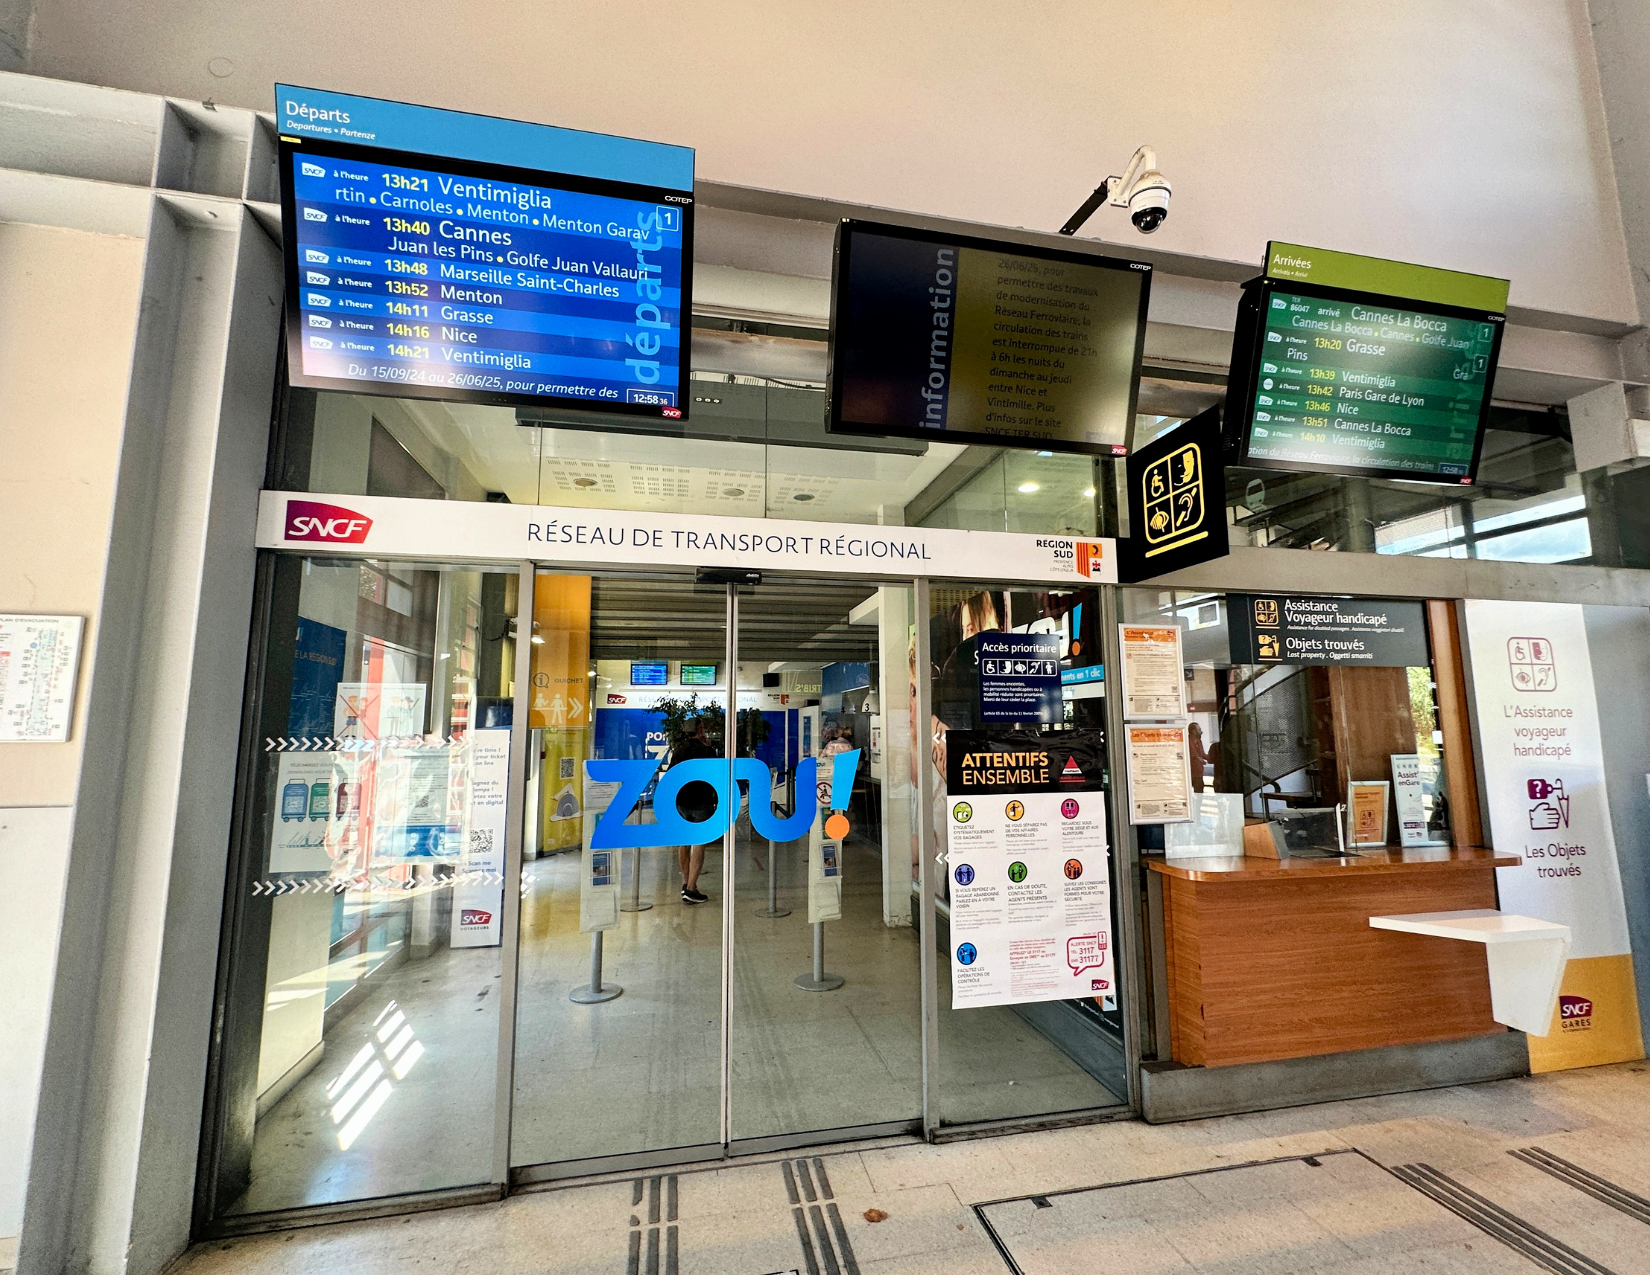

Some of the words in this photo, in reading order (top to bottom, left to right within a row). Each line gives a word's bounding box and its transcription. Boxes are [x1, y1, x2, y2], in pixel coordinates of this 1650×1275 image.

[286, 101, 350, 123] Départs
[287, 120, 332, 133] Departures
[340, 128, 375, 140] Partenze
[333, 169, 338, 178] à
[340, 171, 369, 181] l'heure
[382, 171, 428, 192] 13h21
[438, 176, 551, 210] Ventimiglia
[335, 187, 365, 203] rtin
[380, 191, 453, 214] Carnoles
[467, 203, 529, 225] Menton
[543, 213, 602, 235] Menton
[606, 222, 650, 241] Garav
[664, 212, 672, 226] 1
[334, 214, 340, 222] à
[342, 215, 370, 226] l'heure
[383, 217, 430, 235] 13h40
[439, 220, 512, 246] Cannes
[388, 236, 428, 255] Juan
[434, 242, 456, 258] les
[461, 245, 494, 262] Pins
[506, 250, 549, 270] Golfe
[551, 256, 589, 274] Juan
[592, 260, 648, 281] Vallauri
[1273, 254, 1312, 269] Arrivées
[336, 255, 342, 263] à
[343, 256, 372, 267] l'heure
[384, 259, 428, 275] 13h48
[440, 263, 512, 285] Marseille
[517, 272, 620, 298] Saint-Charles
[337, 276, 343, 284] à
[344, 277, 373, 288] l'heure
[385, 281, 429, 297] 13h52
[441, 285, 503, 305] Menton
[625, 211, 671, 385] départs
[338, 298, 344, 306] à
[345, 299, 373, 310] l'heure
[386, 302, 428, 317] 14h11
[441, 306, 494, 324] Grasse
[1318, 307, 1340, 317] arrivé
[1351, 306, 1394, 324] Cannes
[1397, 313, 1410, 327] La
[1413, 315, 1447, 332] Bocca
[339, 320, 345, 328] à
[345, 320, 374, 331] l'heure
[386, 323, 430, 339] 14h16
[442, 326, 478, 344] Nice
[919, 248, 954, 429] information
[1292, 315, 1328, 330] Cannes
[1331, 320, 1341, 332] La
[1344, 322, 1373, 336] Bocca
[1380, 327, 1414, 342] Cannes
[1421, 333, 1446, 346] Golfe
[1447, 337, 1469, 349] Juan
[1483, 328, 1489, 337] 1
[1287, 347, 1308, 361] Pins
[1314, 337, 1342, 350] 13h20
[1346, 339, 1386, 356] Grasse
[340, 341, 346, 349] à
[346, 342, 375, 352] l'heure
[387, 344, 429, 360] 14h21
[442, 347, 531, 370] Ventimiglia
[991, 351, 997, 361] à
[1013, 355, 1026, 365] les
[1028, 357, 1050, 367] nuits
[1053, 358, 1065, 369] du
[1478, 359, 1484, 368] 1
[348, 364, 367, 376] Du
[371, 366, 426, 383] 15/09/24
[428, 373, 445, 384] au
[448, 373, 504, 390] 26/06/25,
[506, 380, 536, 392] pour
[537, 381, 597, 398] permettre
[599, 387, 619, 399] des
[990, 367, 1035, 382] dimanche
[1037, 373, 1048, 382] au
[1049, 373, 1072, 388] jeudi
[1309, 368, 1335, 380] 13h39
[1342, 371, 1395, 388] Ventimiglia
[988, 384, 1013, 394] entre
[1015, 384, 1036, 396] Nice
[1038, 388, 1047, 397] et
[1307, 384, 1333, 396] 13h42
[1339, 387, 1362, 399] Paris
[1364, 390, 1386, 402] Gare
[1389, 393, 1401, 403] de
[1402, 394, 1424, 407] Lyon
[633, 393, 659, 405] 12:58
[1036, 401, 1055, 413] Plus
[1304, 400, 1331, 412] 13h46
[1337, 403, 1359, 414] Nice
[663, 409, 682, 417] SNCF
[986, 412, 1016, 424] d'infos
[1018, 415, 1032, 425] sur
[1035, 416, 1043, 426] le
[1045, 417, 1062, 428] site
[1302, 416, 1328, 427] 13h51
[1334, 418, 1368, 432] Cannes
[1371, 422, 1381, 432] La
[1384, 423, 1411, 436] Bocca
[1300, 432, 1326, 443] 14h10
[1332, 434, 1385, 450] Ventimiglia
[288, 517, 367, 538] SNCF
[527, 519, 625, 546] RÉSEAU
[632, 529, 663, 547] DE
[671, 530, 814, 555] TRANSPORT
[819, 535, 932, 560] RÉGIONAL
[1036, 538, 1073, 550] RÉGION
[1054, 549, 1073, 558] SUD
[1284, 599, 1338, 612] Assistance
[1285, 611, 1333, 626] Voyageur
[1336, 612, 1388, 628] handicapé
[982, 642, 1009, 652] Accès
[1011, 643, 1057, 654] prioritaire
[1285, 637, 1322, 652] Objets
[1324, 638, 1365, 651] trouvés
[1287, 651, 1300, 659] Lost
[1300, 651, 1326, 660] property
[1329, 651, 1351, 660] Oggetti
[554, 677, 583, 685] GUICHET
[1503, 705, 1574, 719] L'Assistance
[1514, 726, 1568, 741] voyageur
[491, 752, 506, 760] ticket
[1513, 743, 1572, 760] handicapé
[961, 751, 1049, 769] ATTENTIFS
[962, 769, 1050, 785] ENSEMBLE
[487, 799, 504, 808] digital
[586, 747, 862, 849] ZOU!
[1525, 845, 1545, 859] Les
[1547, 843, 1587, 861] Objets
[1537, 863, 1582, 879] trouvés
[462, 914, 490, 925] SNCF
[1078, 946, 1095, 955] 3117
[1079, 954, 1099, 963] 31177
[1092, 982, 1108, 990] SNCF
[1562, 1002, 1591, 1017] SNCF
[1562, 1018, 1591, 1029] GARES
